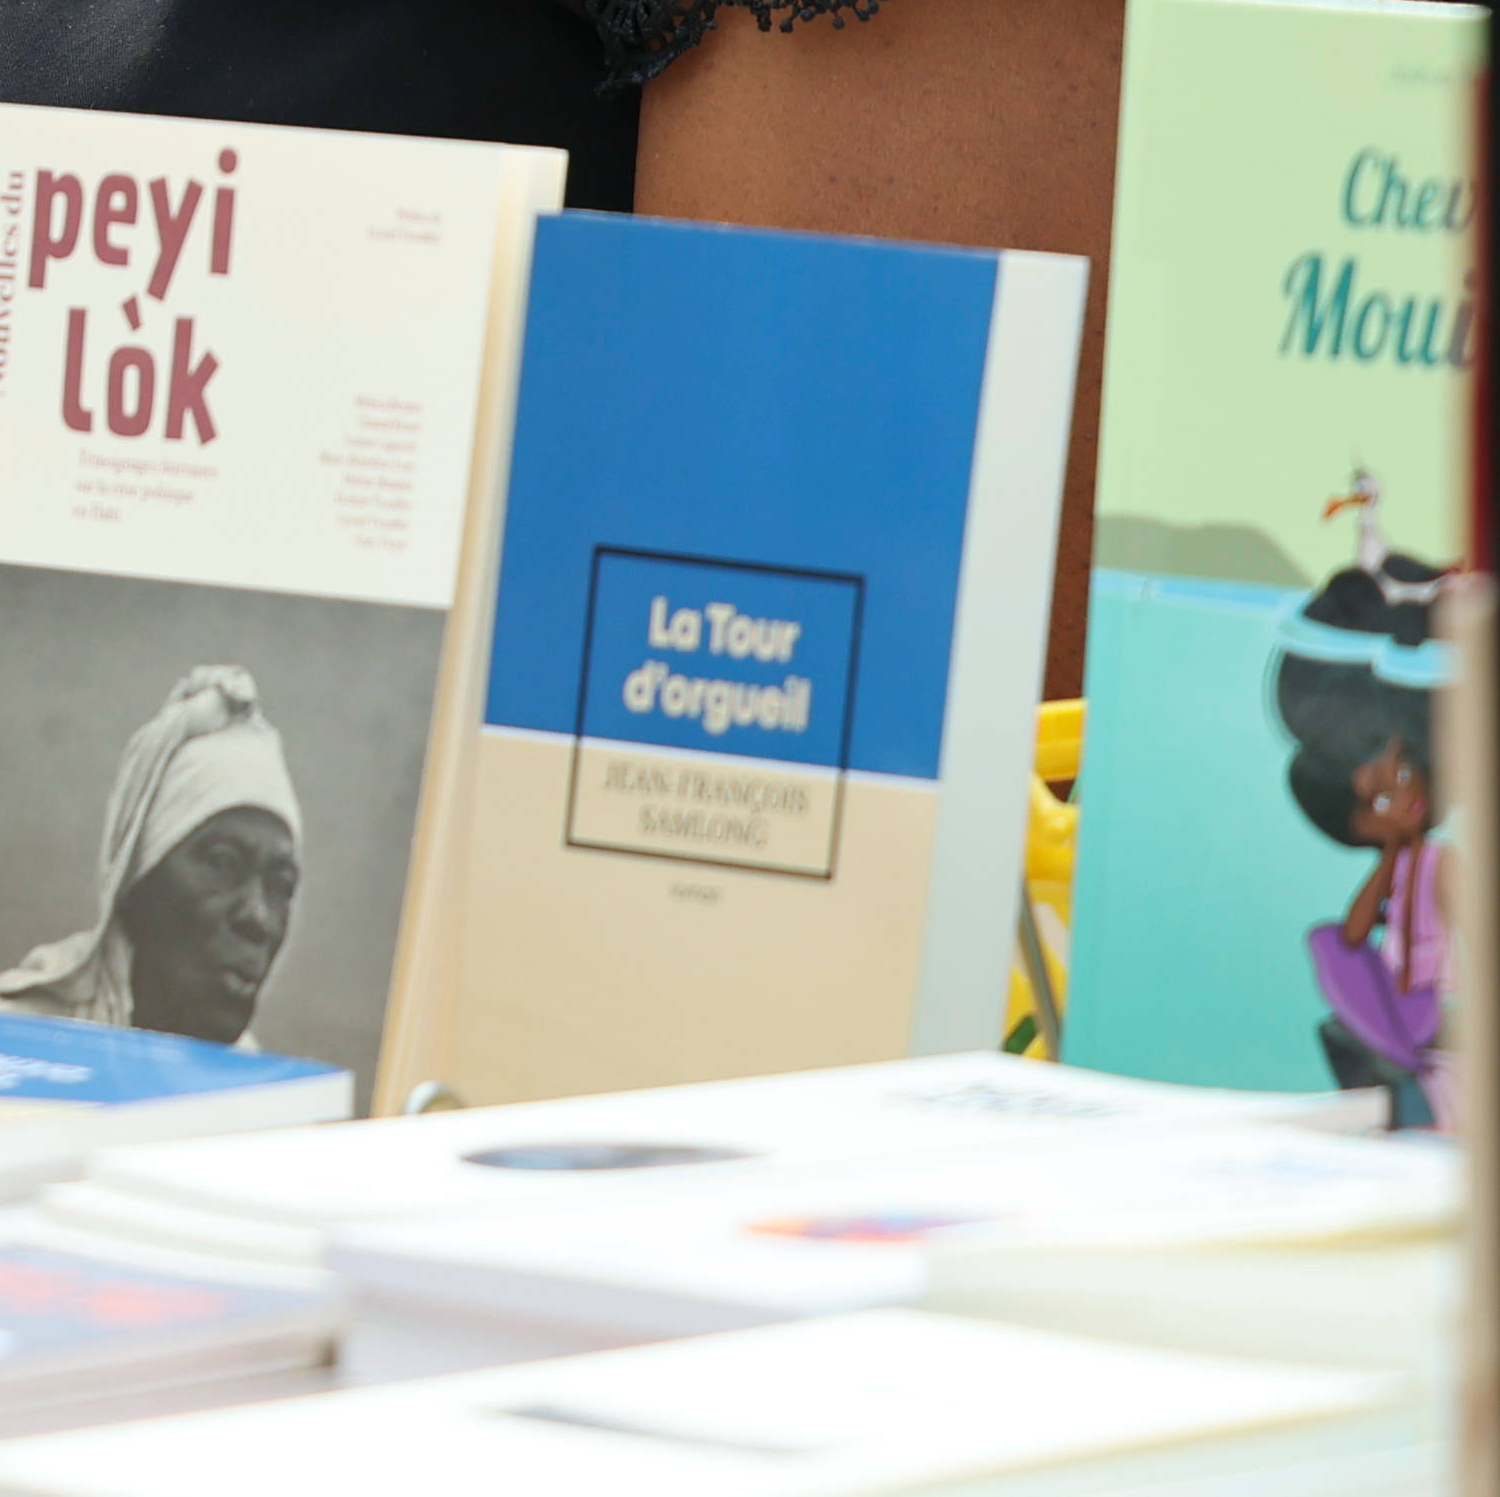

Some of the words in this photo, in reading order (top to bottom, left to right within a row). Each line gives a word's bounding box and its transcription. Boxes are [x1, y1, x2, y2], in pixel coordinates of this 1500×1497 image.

[0, 170, 25, 215] du
[28, 148, 238, 300] peyi
[61, 295, 220, 446] lòk
[648, 594, 702, 652] La
[704, 601, 801, 663] Tour
[622, 659, 812, 735] d'orgueil
